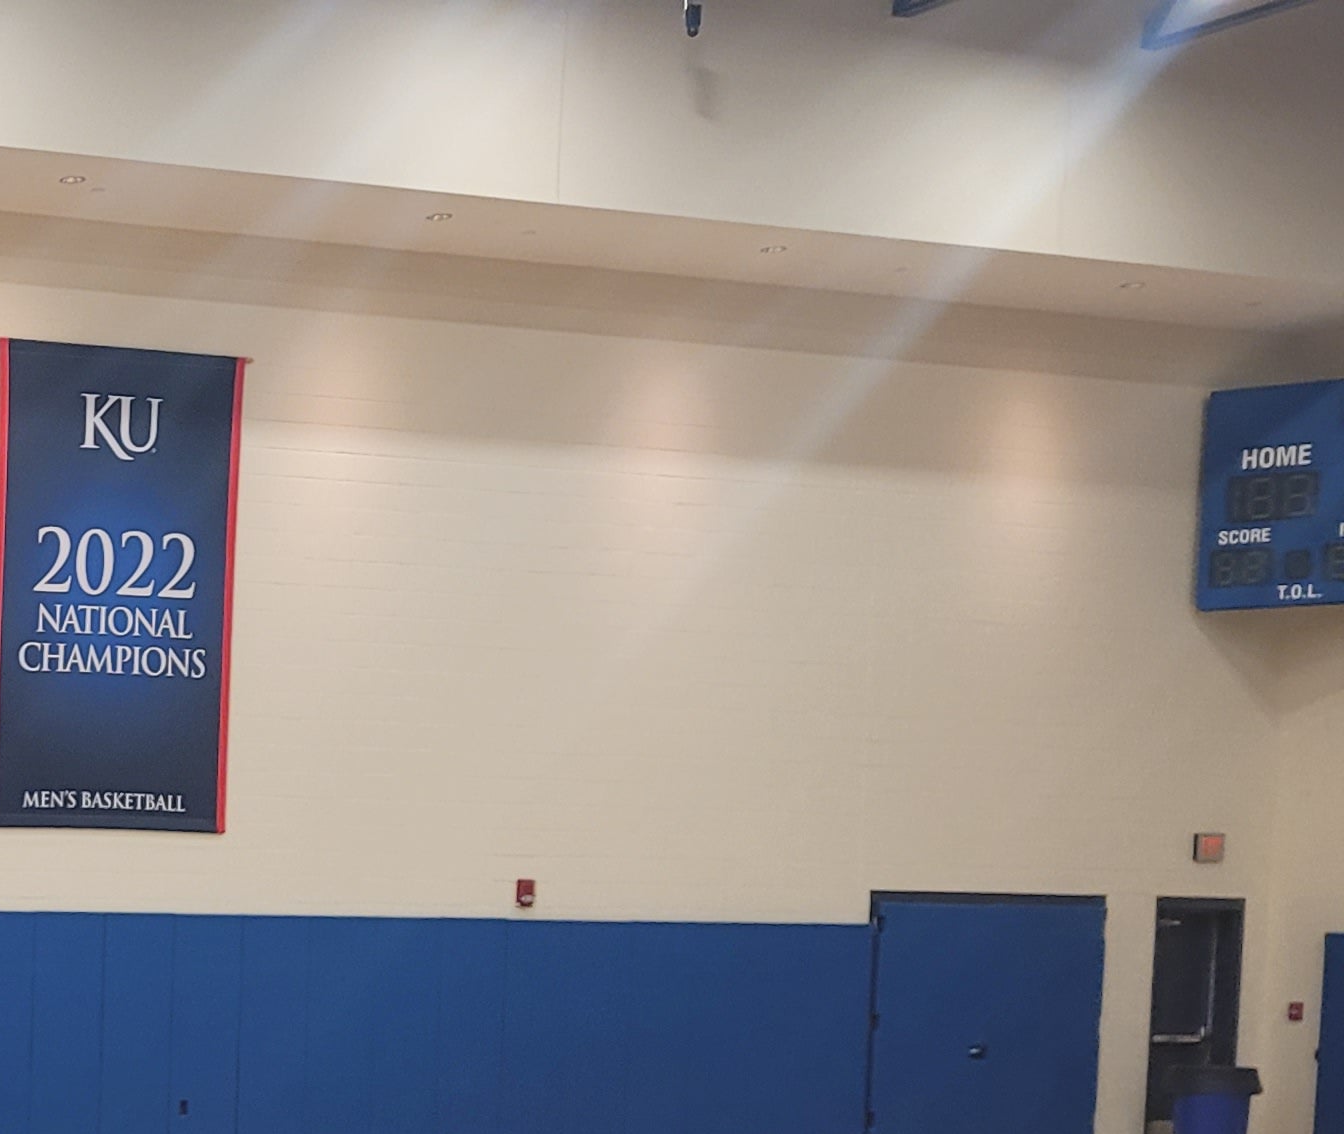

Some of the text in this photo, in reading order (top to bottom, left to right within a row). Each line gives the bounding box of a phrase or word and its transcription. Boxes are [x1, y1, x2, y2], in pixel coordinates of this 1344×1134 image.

[79, 393, 163, 461] KU
[1241, 444, 1313, 470] HOME
[1218, 528, 1272, 546] SCORE
[33, 526, 196, 599] 2022
[1277, 583, 1323, 600] T.O.L.
[36, 602, 193, 640] NATIONAL
[17, 640, 207, 679] CHAMPIONS
[23, 791, 186, 812] MEN'S BASKETBALL
